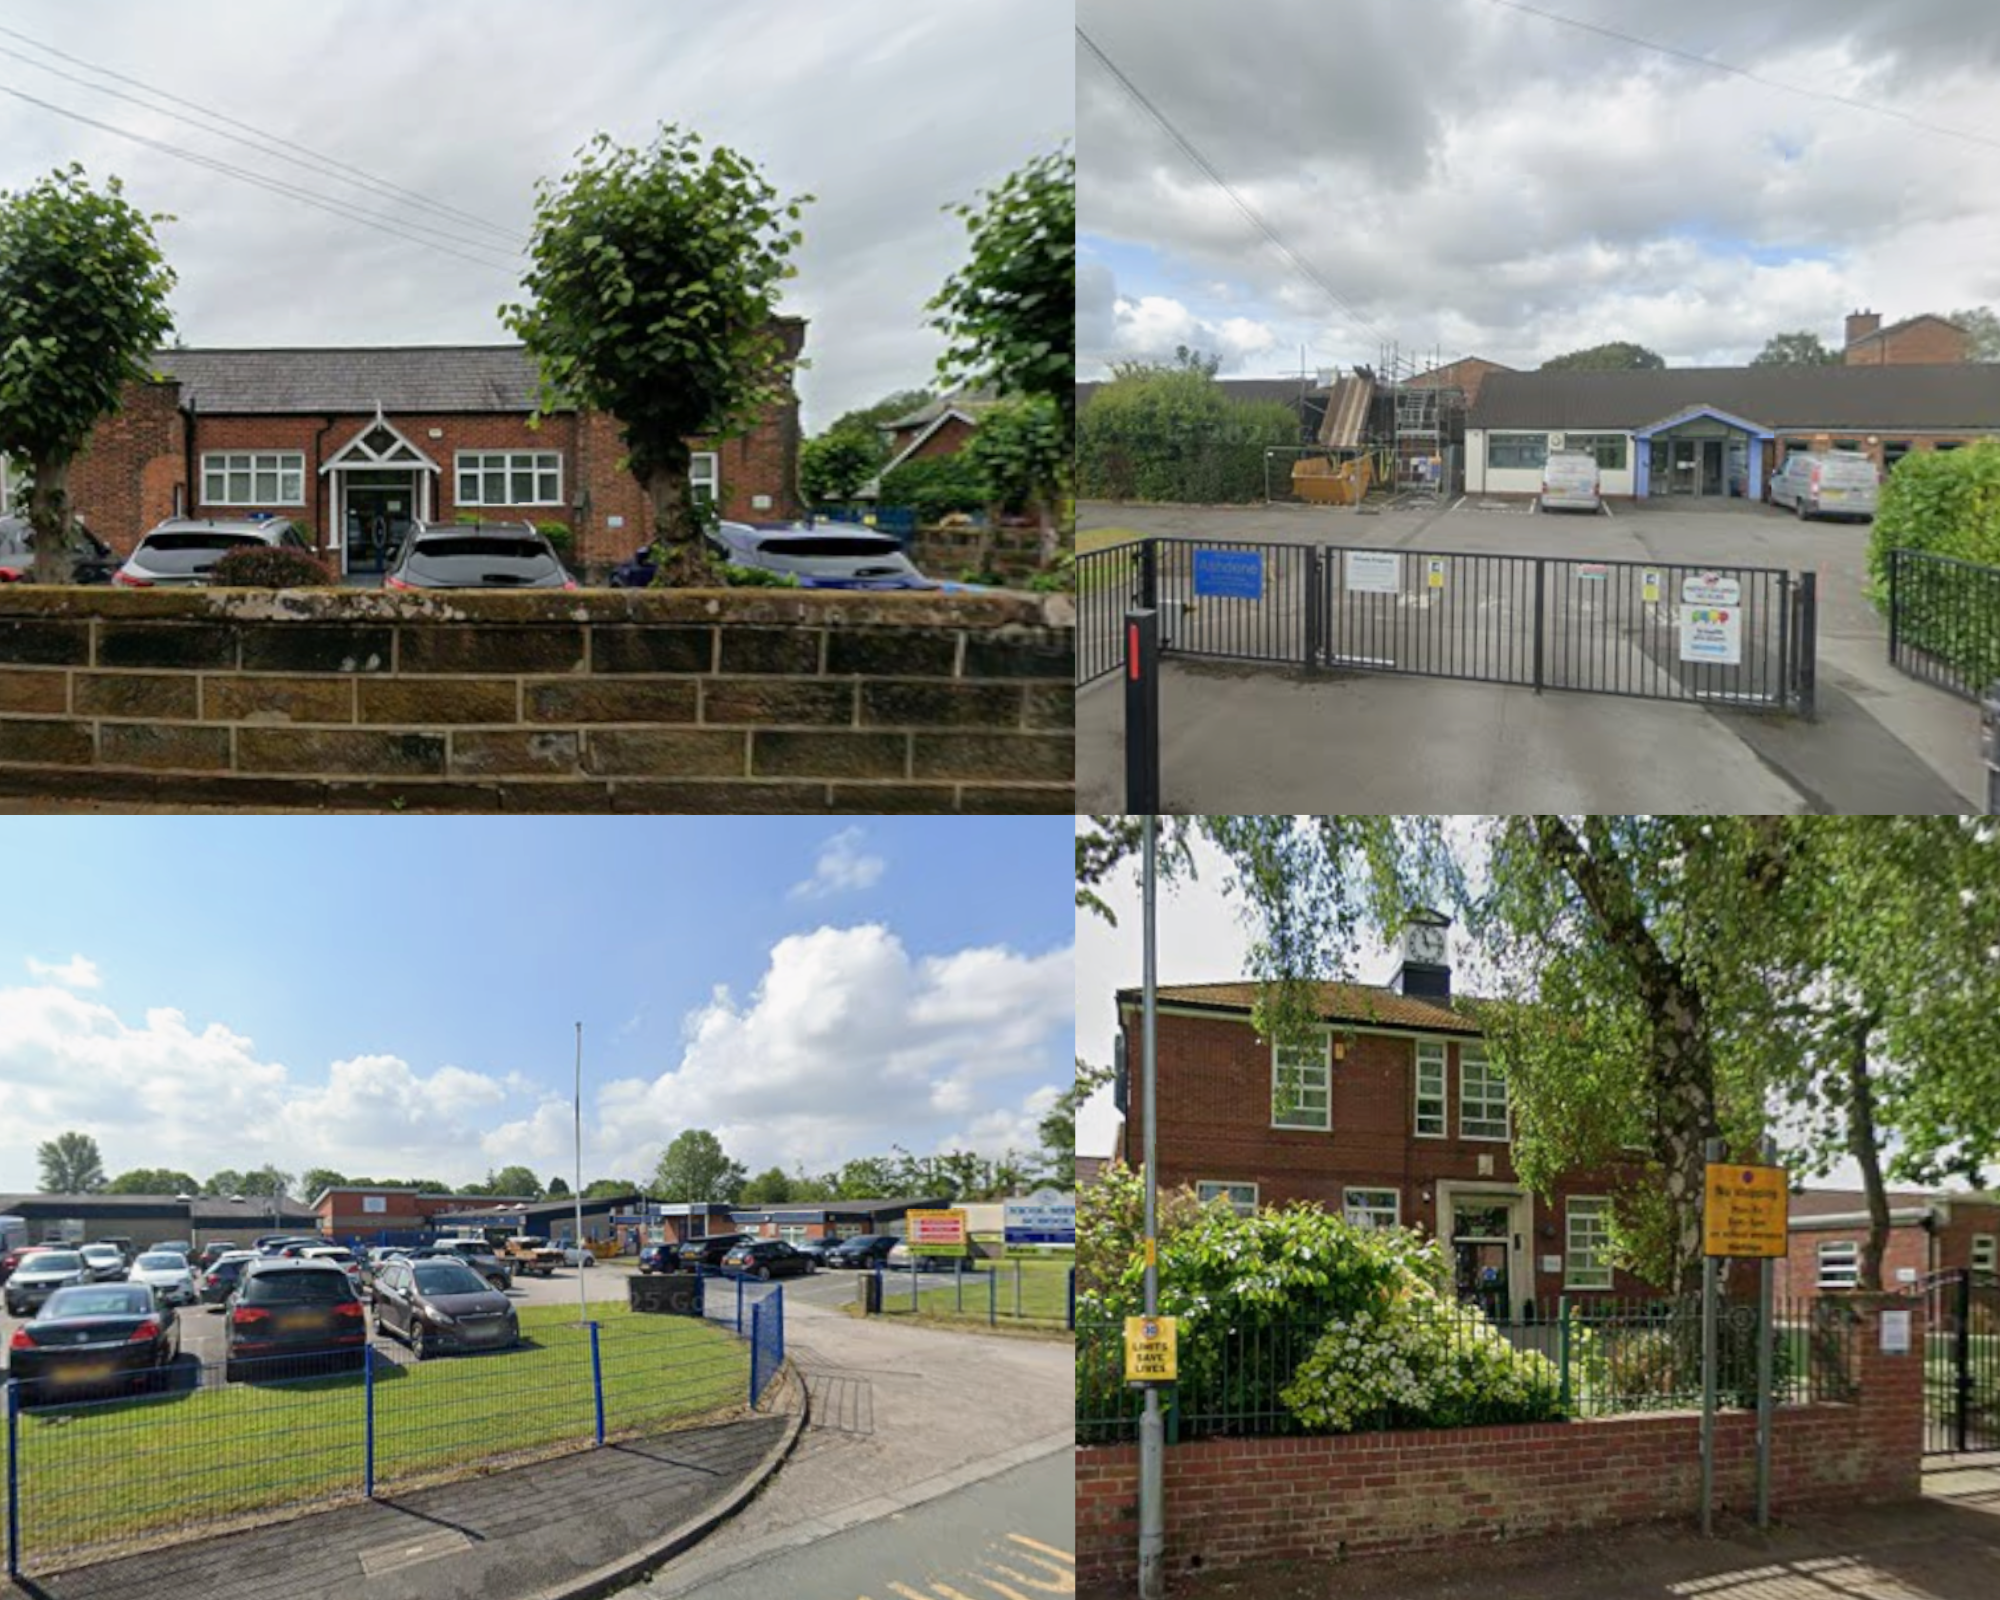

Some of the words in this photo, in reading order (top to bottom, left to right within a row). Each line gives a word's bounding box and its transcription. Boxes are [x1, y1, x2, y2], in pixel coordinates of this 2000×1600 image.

[1132, 1341, 1168, 1352] LIMITS
[1136, 1353, 1165, 1362] SAVE
[1135, 1365, 1165, 1373] LIVES
